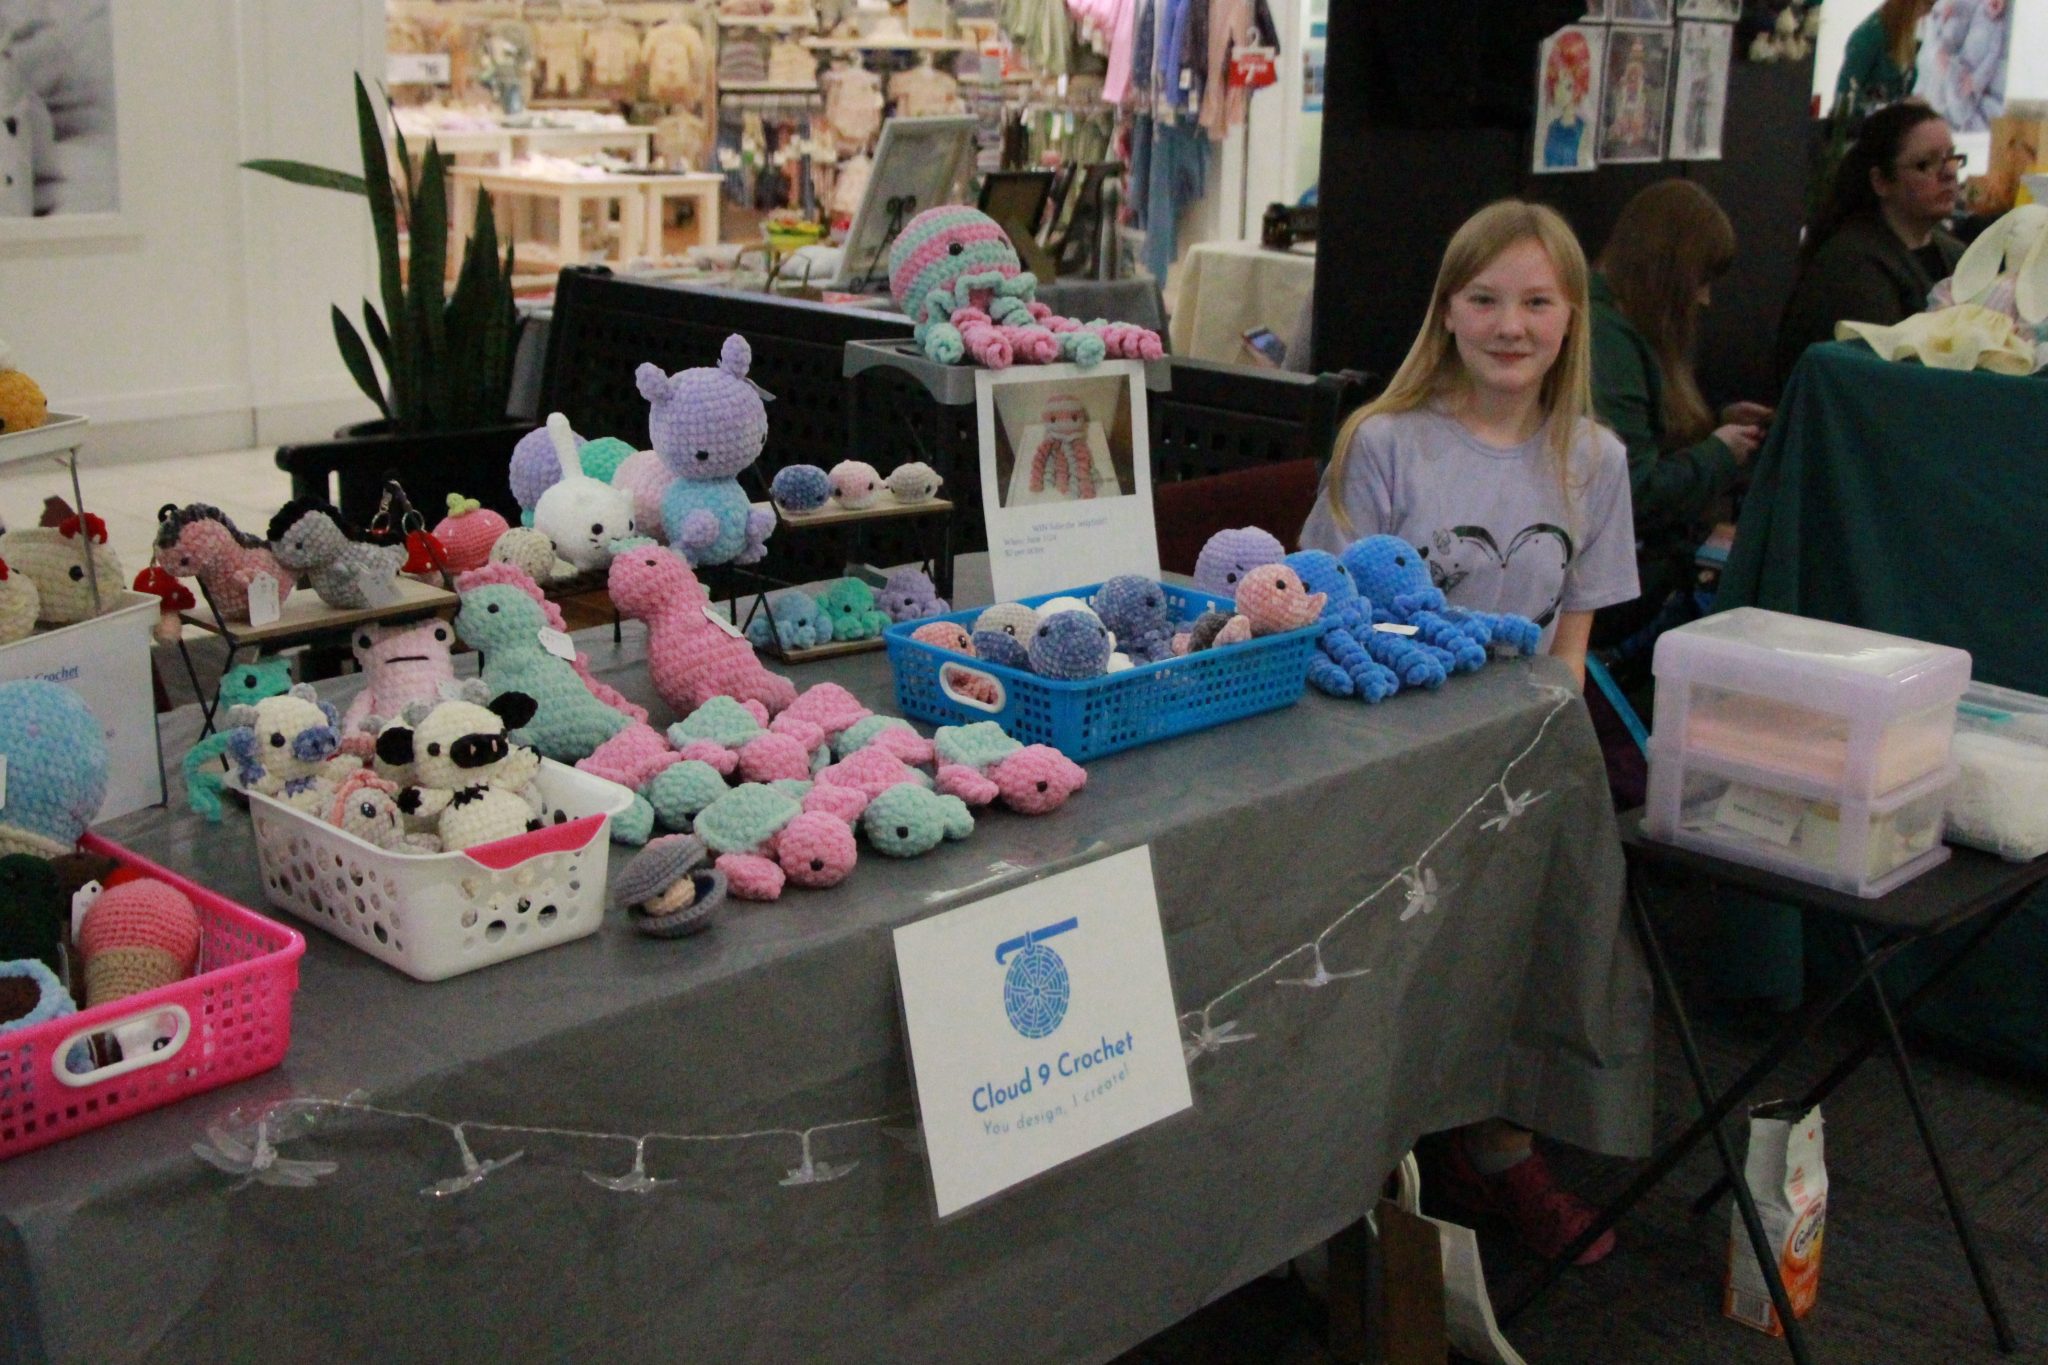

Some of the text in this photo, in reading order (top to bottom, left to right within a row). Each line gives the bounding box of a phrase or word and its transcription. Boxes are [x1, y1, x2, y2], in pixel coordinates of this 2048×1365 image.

[972, 1031, 1133, 1113] Cloud 9 Crochet
[983, 1119, 1010, 1135] You
[1072, 1094, 1078, 1107] I
[1084, 1061, 1129, 1103] create!
